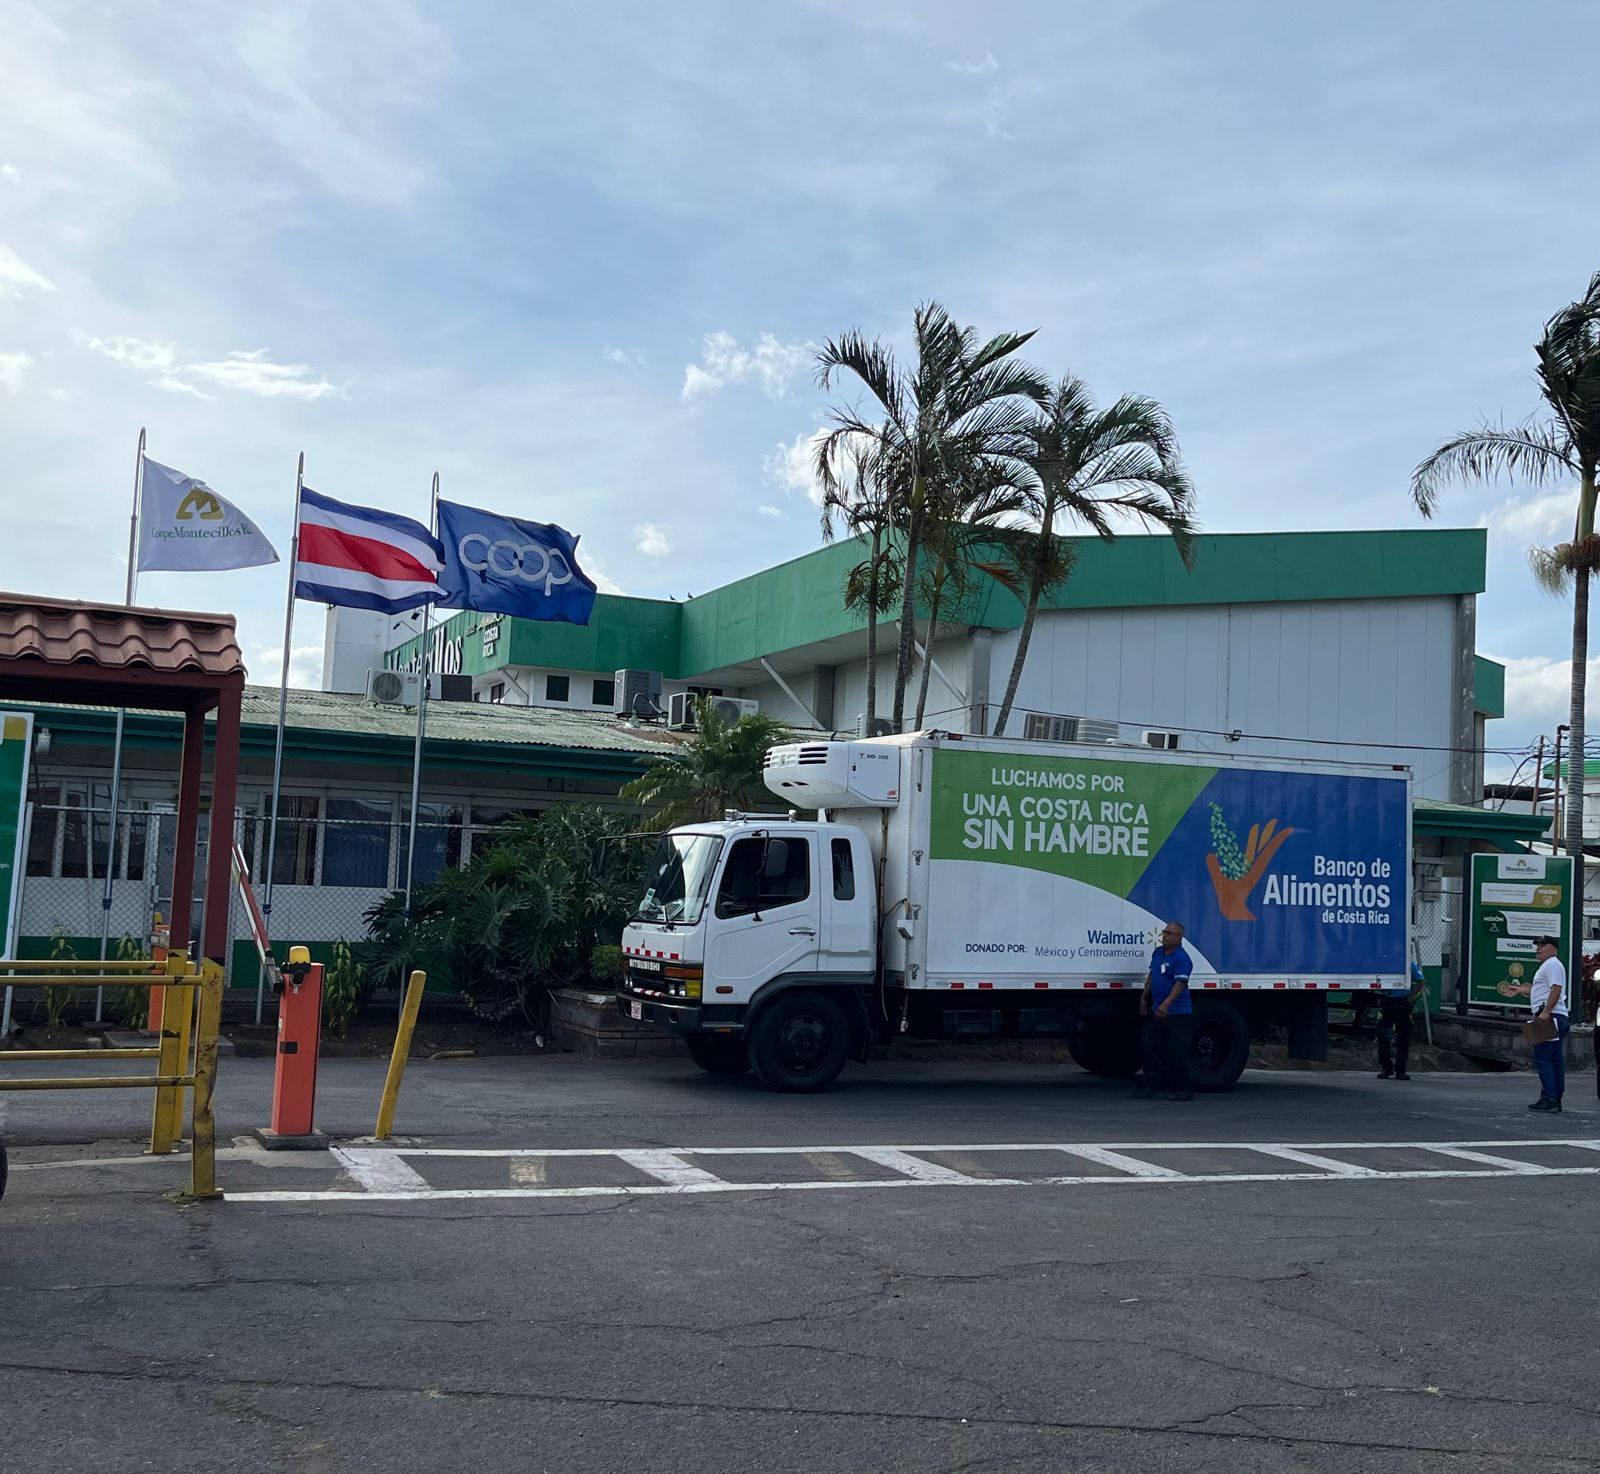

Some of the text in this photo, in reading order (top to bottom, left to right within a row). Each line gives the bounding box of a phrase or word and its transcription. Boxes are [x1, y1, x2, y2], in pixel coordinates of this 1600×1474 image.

[991, 768, 1125, 793] LUCHAMOS POR
[962, 793, 1149, 825] UNA COSTA RICA
[962, 817, 1149, 857] SIN HAMBRE
[1314, 855, 1391, 878] Banco de
[1262, 874, 1391, 908] Alimentos
[1322, 909, 1390, 924] de Costa Rica
[965, 943, 1028, 953] DONADO POR:
[1087, 929, 1145, 945] Walmart
[1034, 946, 1145, 959] México y Centroamérica
